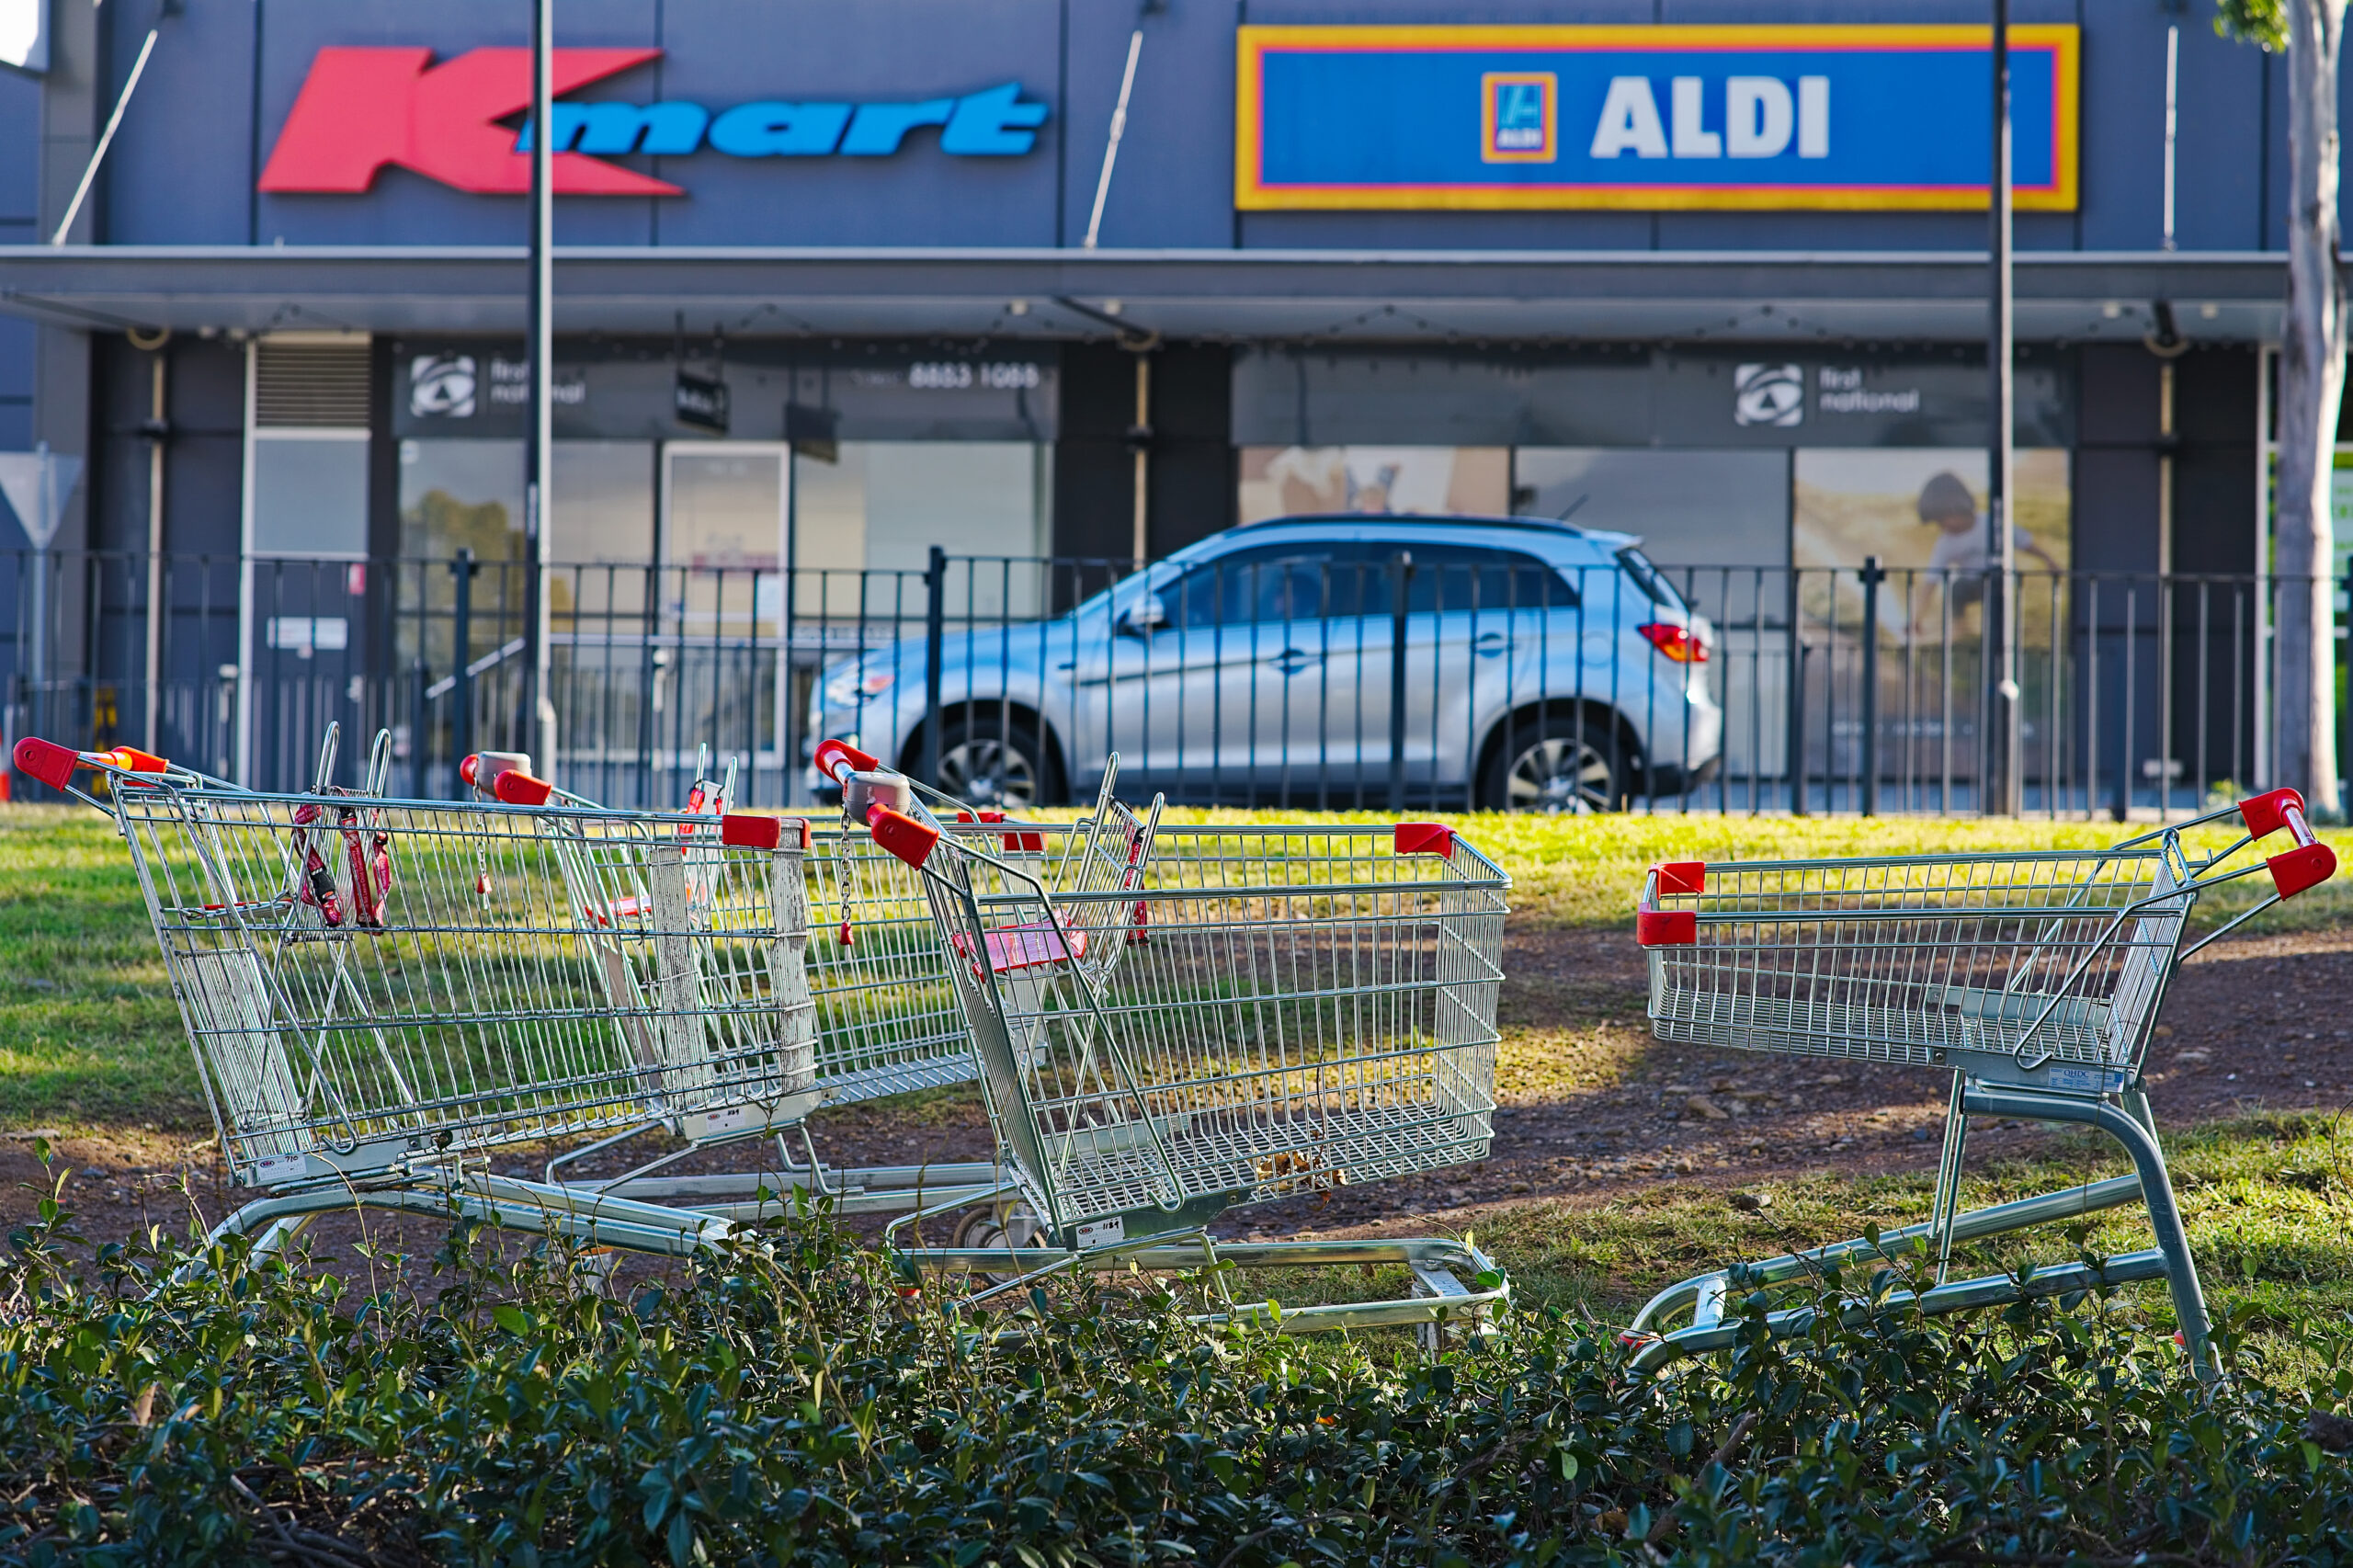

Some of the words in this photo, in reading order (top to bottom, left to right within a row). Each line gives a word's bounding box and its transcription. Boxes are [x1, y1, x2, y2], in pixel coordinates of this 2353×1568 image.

[256, 46, 1049, 196] Kmart
[1589, 75, 1830, 159] ALDI
[1819, 369, 1860, 388] first
[490, 381, 585, 403] natnal
[1819, 389, 1918, 411] national
